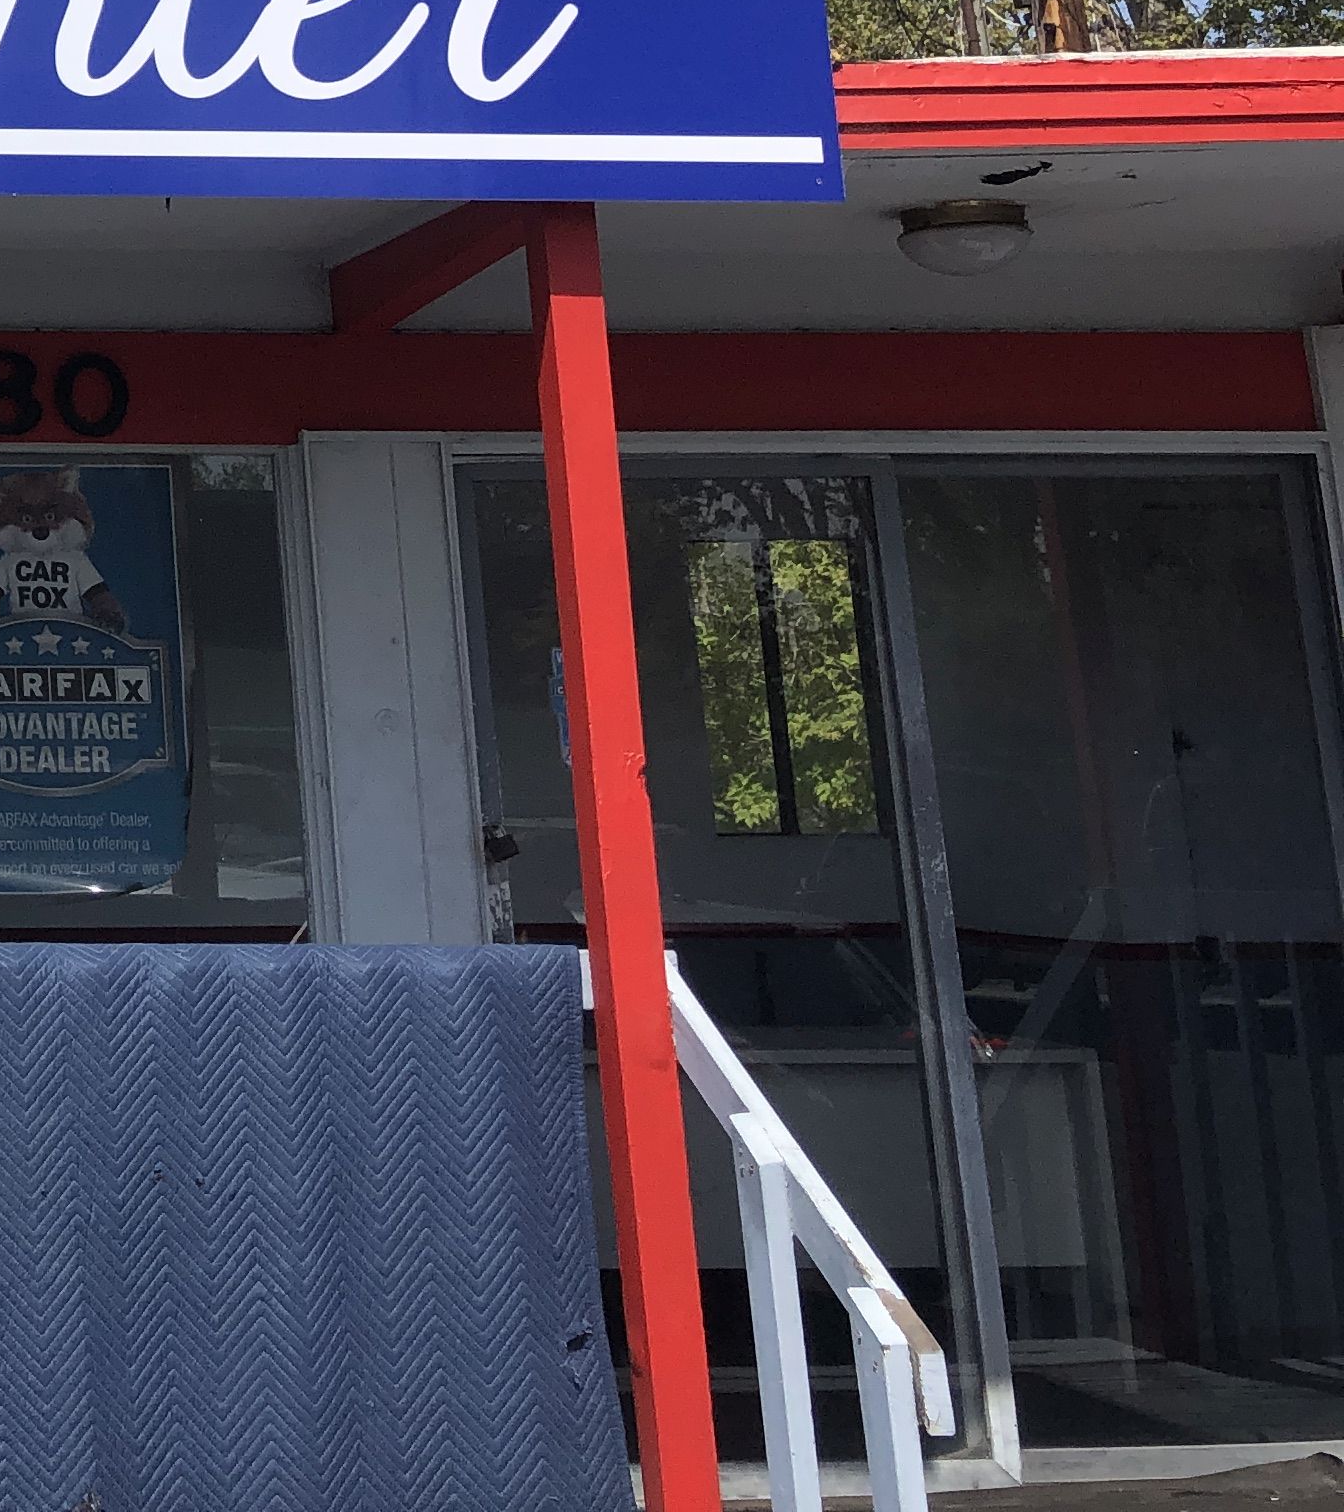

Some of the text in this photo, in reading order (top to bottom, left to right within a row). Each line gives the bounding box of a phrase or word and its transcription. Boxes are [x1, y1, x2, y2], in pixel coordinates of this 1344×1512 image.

[15, 560, 70, 583] CAR
[18, 586, 68, 609] FOX
[0, 745, 111, 774] DEALER
[78, 838, 89, 852] to
[142, 840, 151, 852] a
